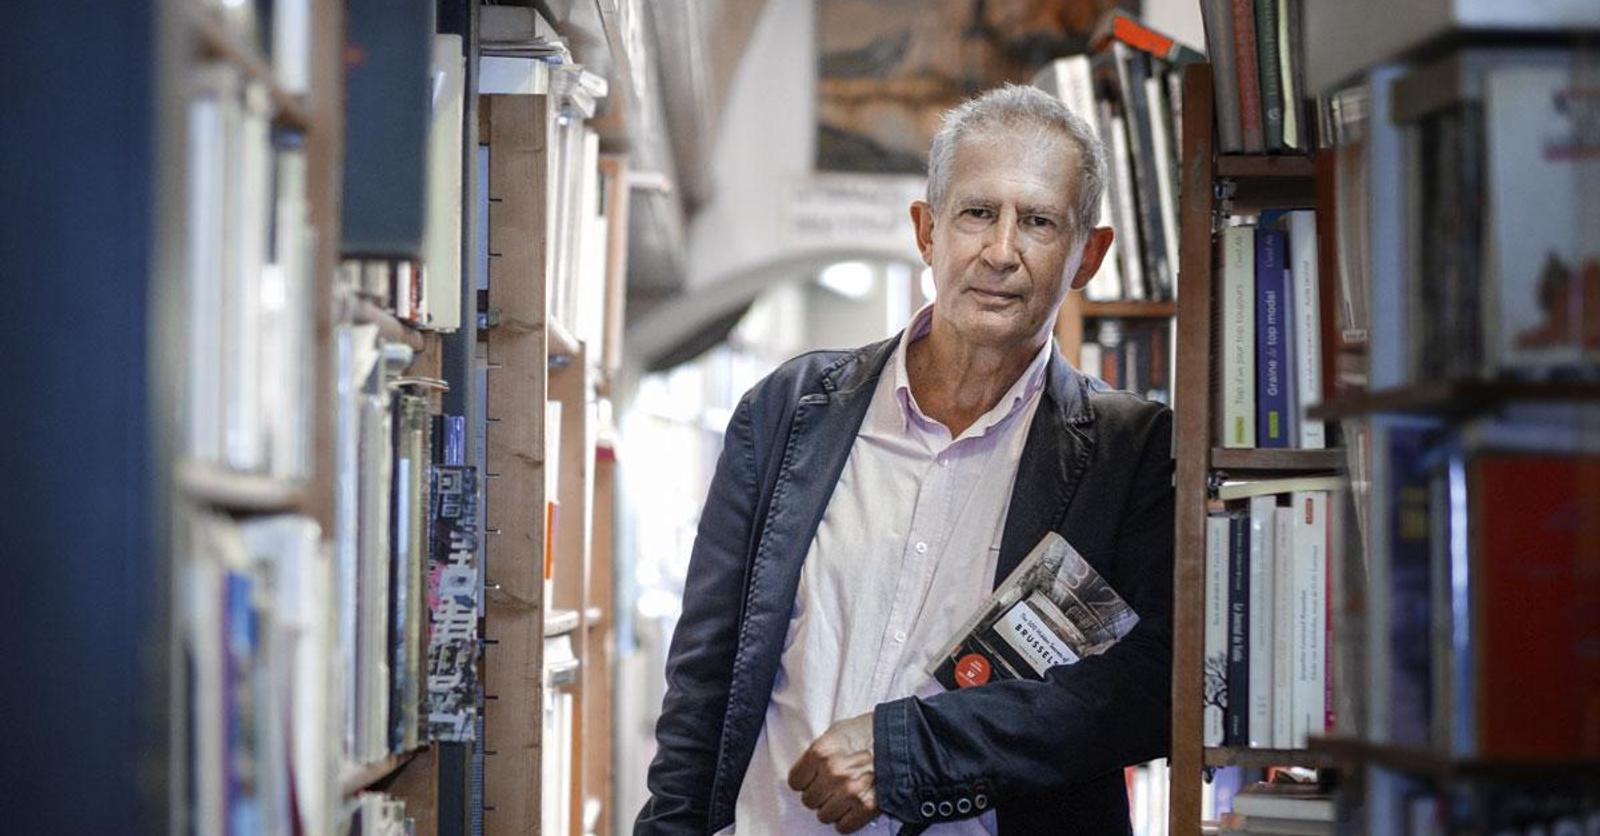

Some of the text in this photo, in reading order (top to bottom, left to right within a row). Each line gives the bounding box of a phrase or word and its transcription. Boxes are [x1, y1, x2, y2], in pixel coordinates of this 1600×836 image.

[1233, 285, 1245, 323] toujours
[1264, 291, 1277, 324] model
[1233, 327, 1245, 343] top
[1266, 327, 1279, 346] top
[1266, 360, 1278, 396] Graine
[1233, 386, 1245, 405] Top
[1233, 602, 1245, 611] Le
[1019, 612, 1028, 622] The
[1233, 612, 1245, 634] Journal
